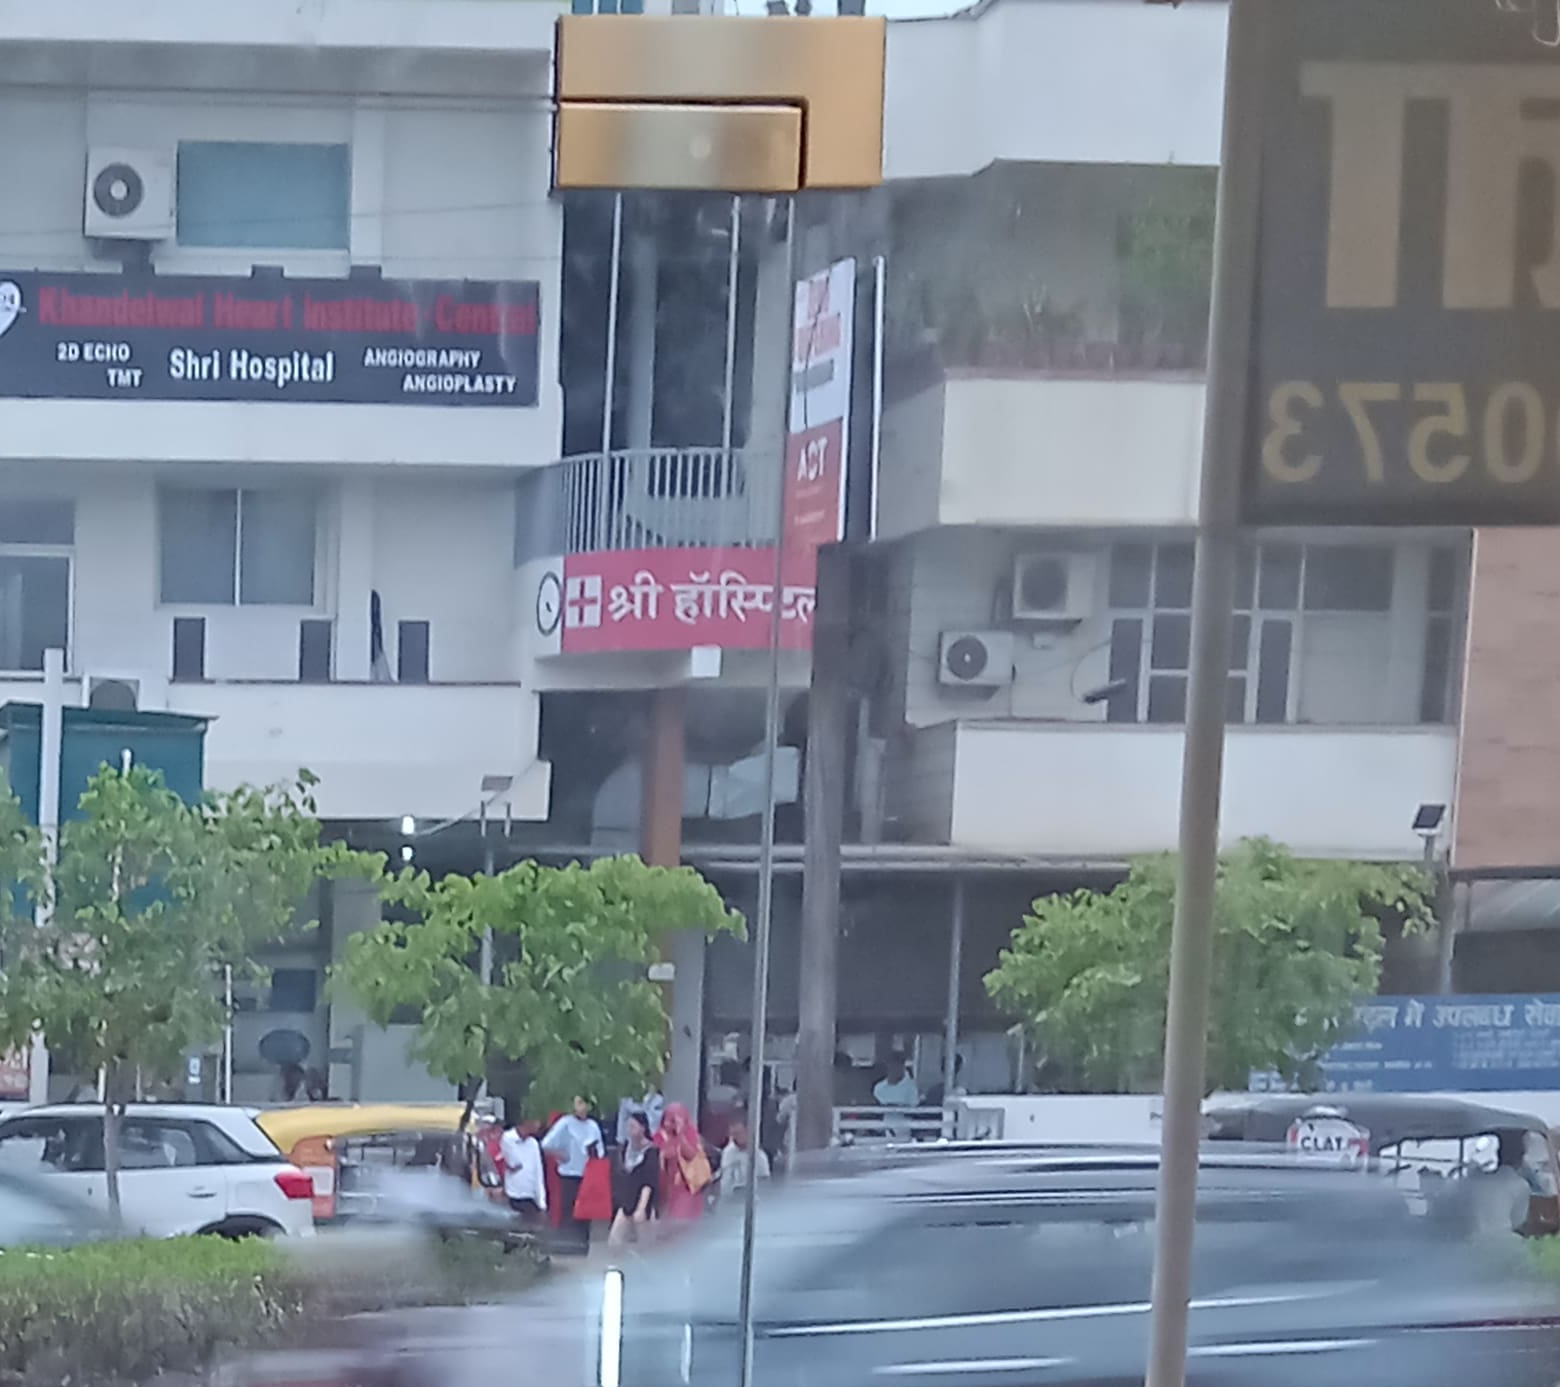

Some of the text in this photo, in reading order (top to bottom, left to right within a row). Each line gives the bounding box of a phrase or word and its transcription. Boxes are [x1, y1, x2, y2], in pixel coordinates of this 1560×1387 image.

[57, 343, 131, 362] 2D ECHO
[364, 347, 482, 370] ANGIOGRAPHY
[107, 367, 143, 388] TMT
[169, 348, 334, 389] Shri Hospital
[402, 373, 518, 394] ANGIOPLASTY
[607, 569, 664, 622] श्री
